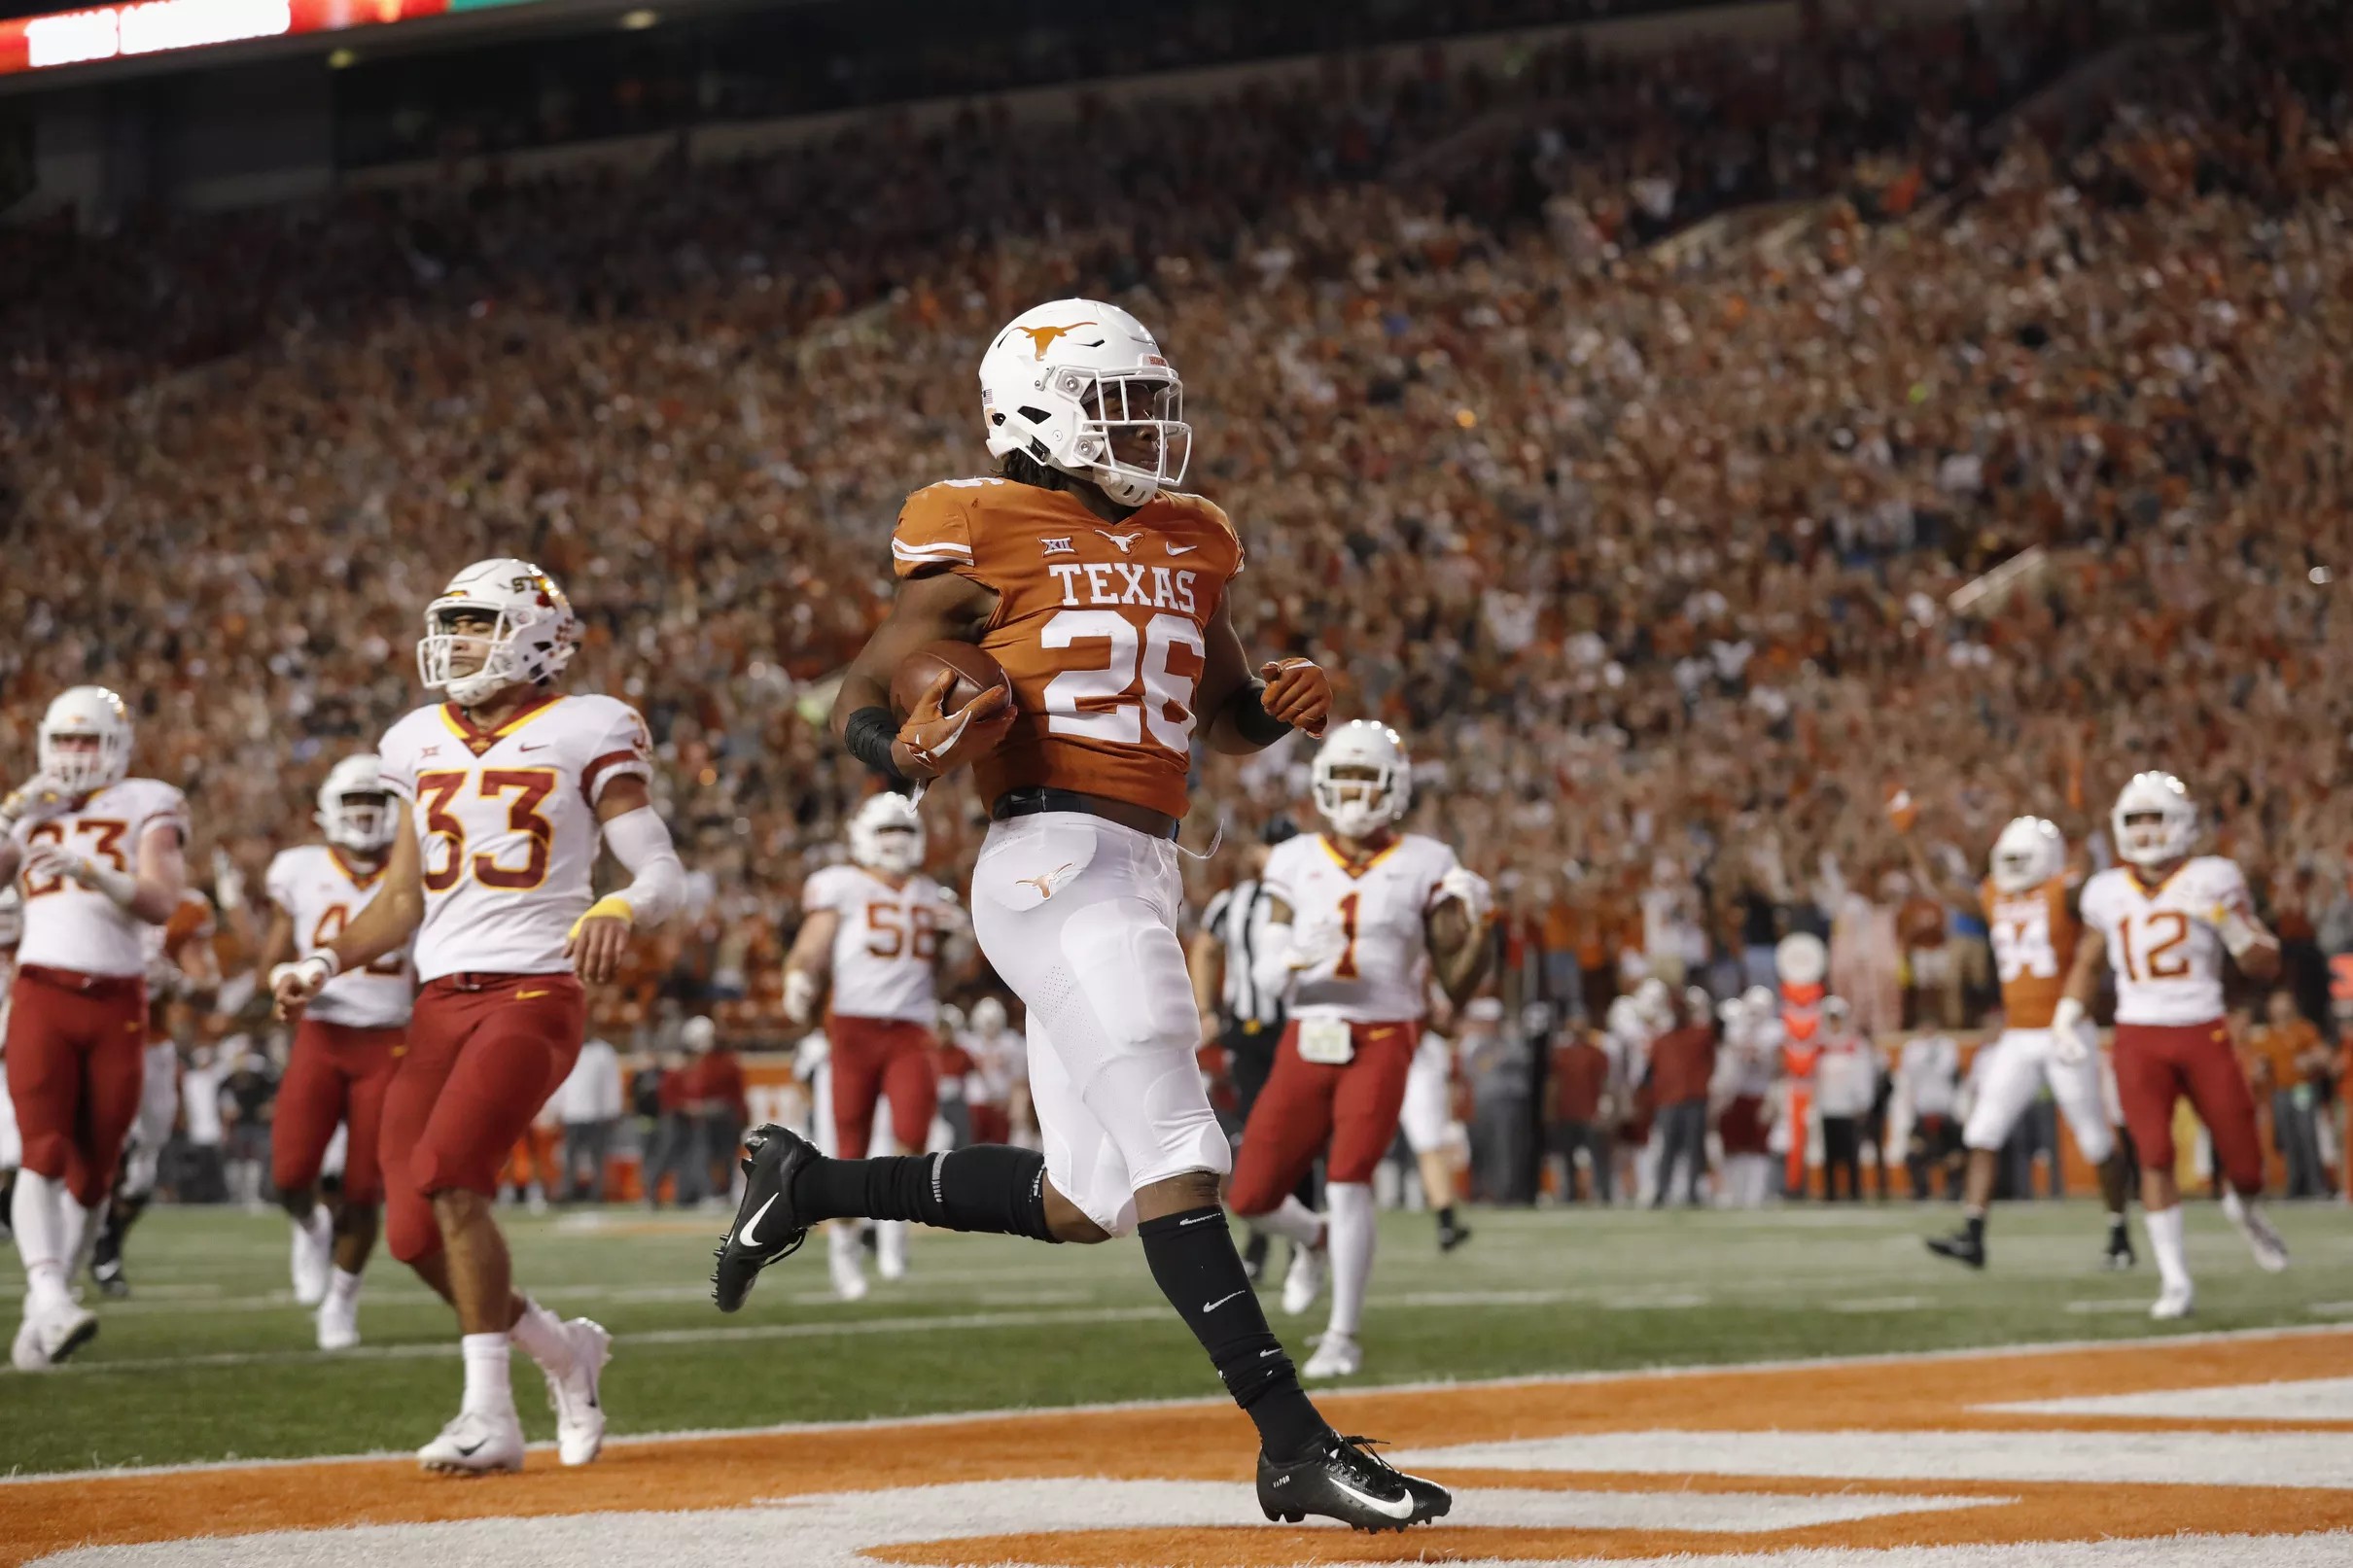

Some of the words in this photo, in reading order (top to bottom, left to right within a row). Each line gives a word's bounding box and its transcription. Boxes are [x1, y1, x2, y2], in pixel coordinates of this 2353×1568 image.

[1048, 563, 1196, 613] TEXAS
[1041, 610, 1206, 753] 26
[416, 767, 558, 893] 33
[1332, 889, 1362, 982] 1
[2118, 908, 2192, 982] 12
